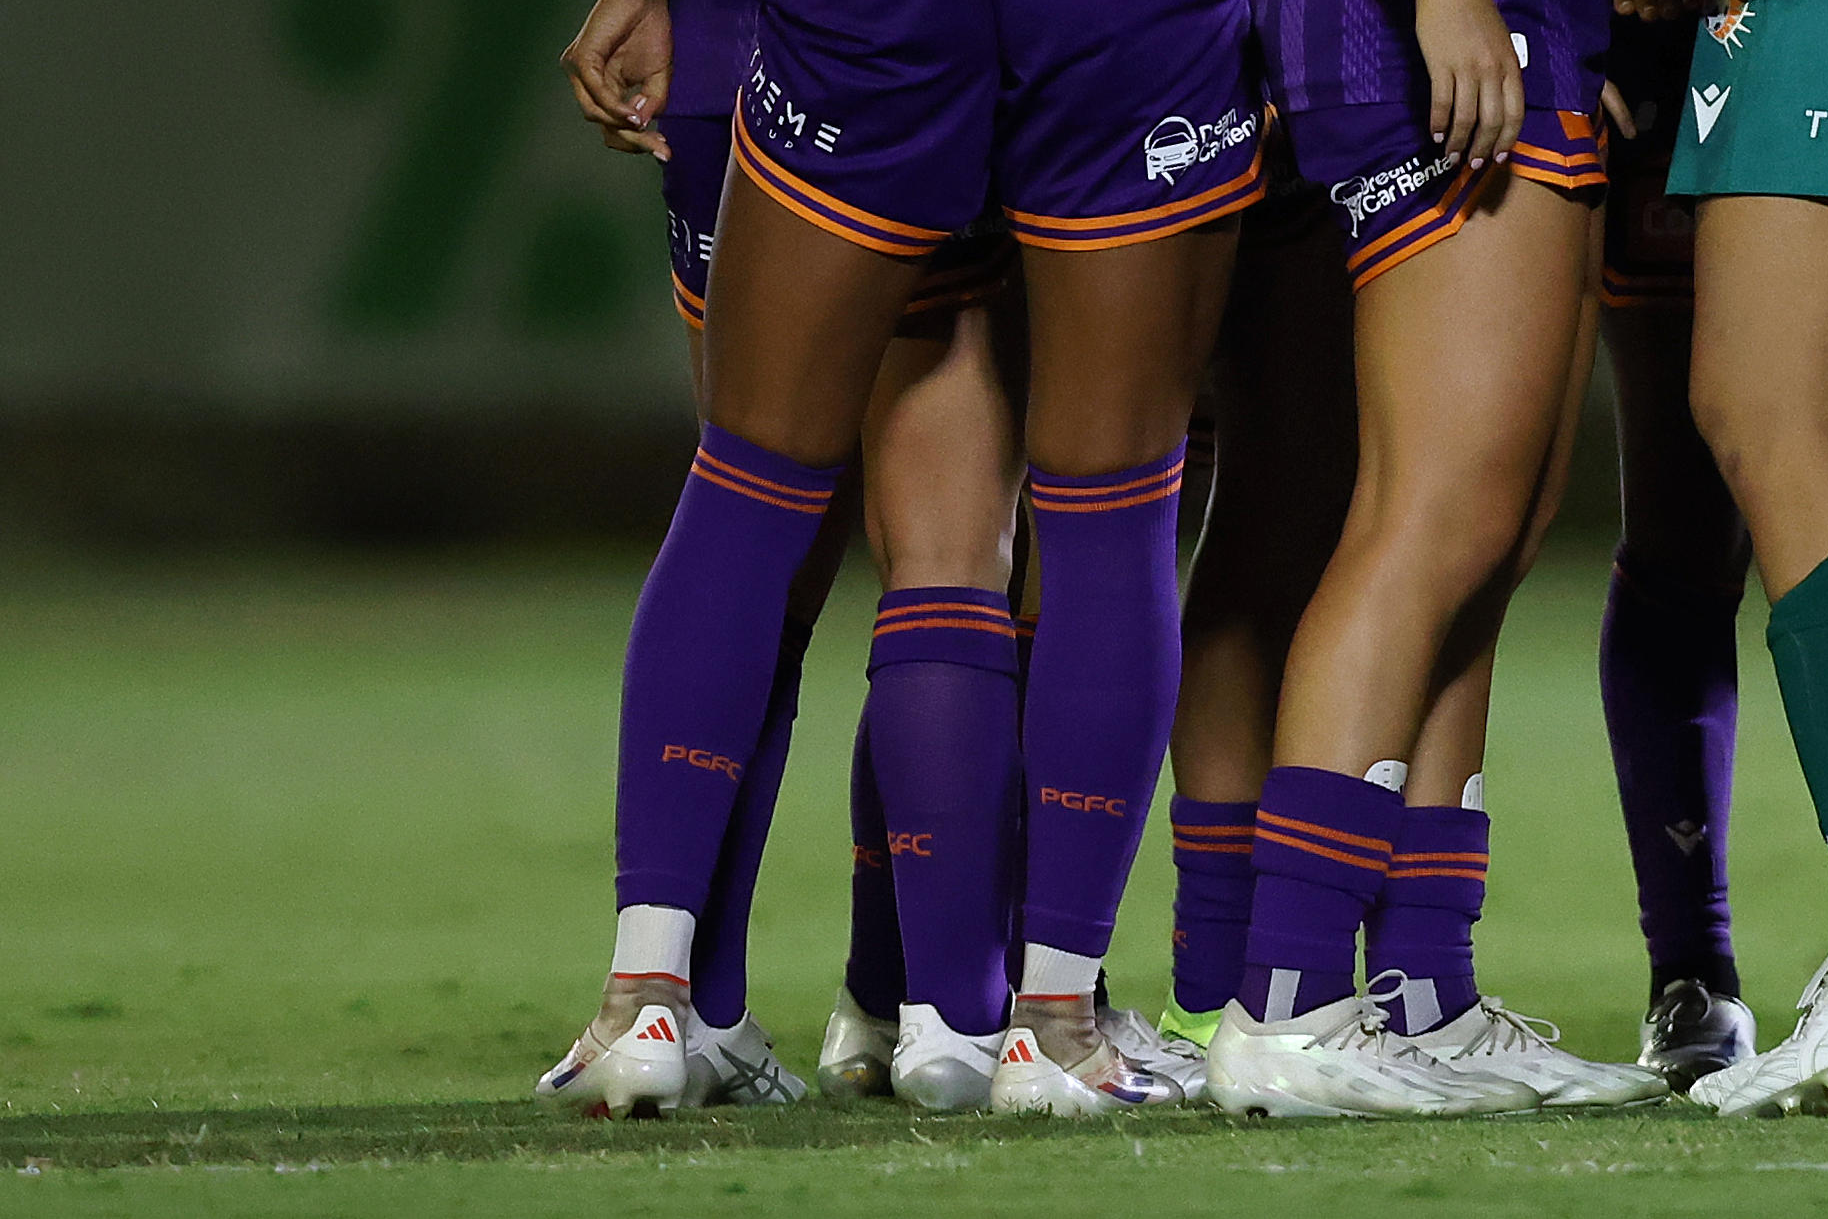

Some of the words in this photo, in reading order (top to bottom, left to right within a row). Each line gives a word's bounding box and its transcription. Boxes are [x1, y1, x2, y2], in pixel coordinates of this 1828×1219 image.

[1362, 184, 1397, 214] Car
[661, 744, 743, 783] PGFC
[1040, 787, 1127, 818] PGFC
